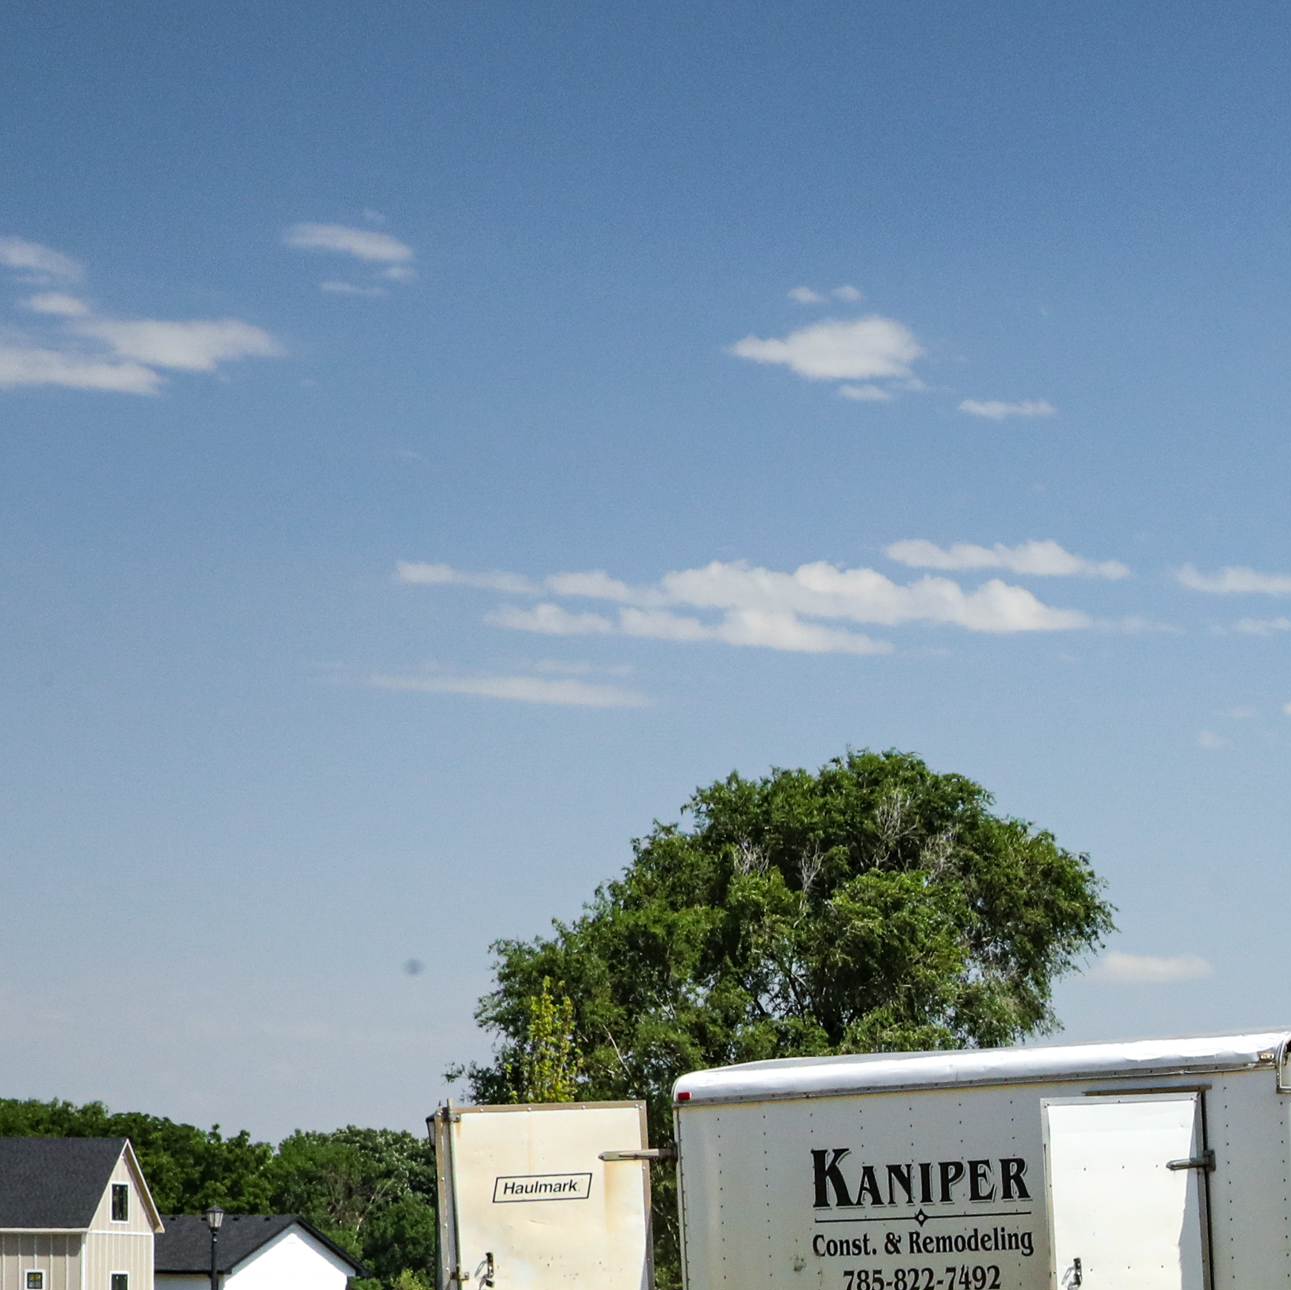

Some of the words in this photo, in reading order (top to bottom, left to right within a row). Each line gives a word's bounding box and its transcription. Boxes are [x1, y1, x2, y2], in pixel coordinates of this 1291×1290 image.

[503, 1179, 578, 1195] Haulmark
[811, 1148, 1032, 1208] KANIPER
[812, 1232, 877, 1257] Const.
[884, 1231, 902, 1255] &
[908, 1227, 1034, 1257] Remodeling
